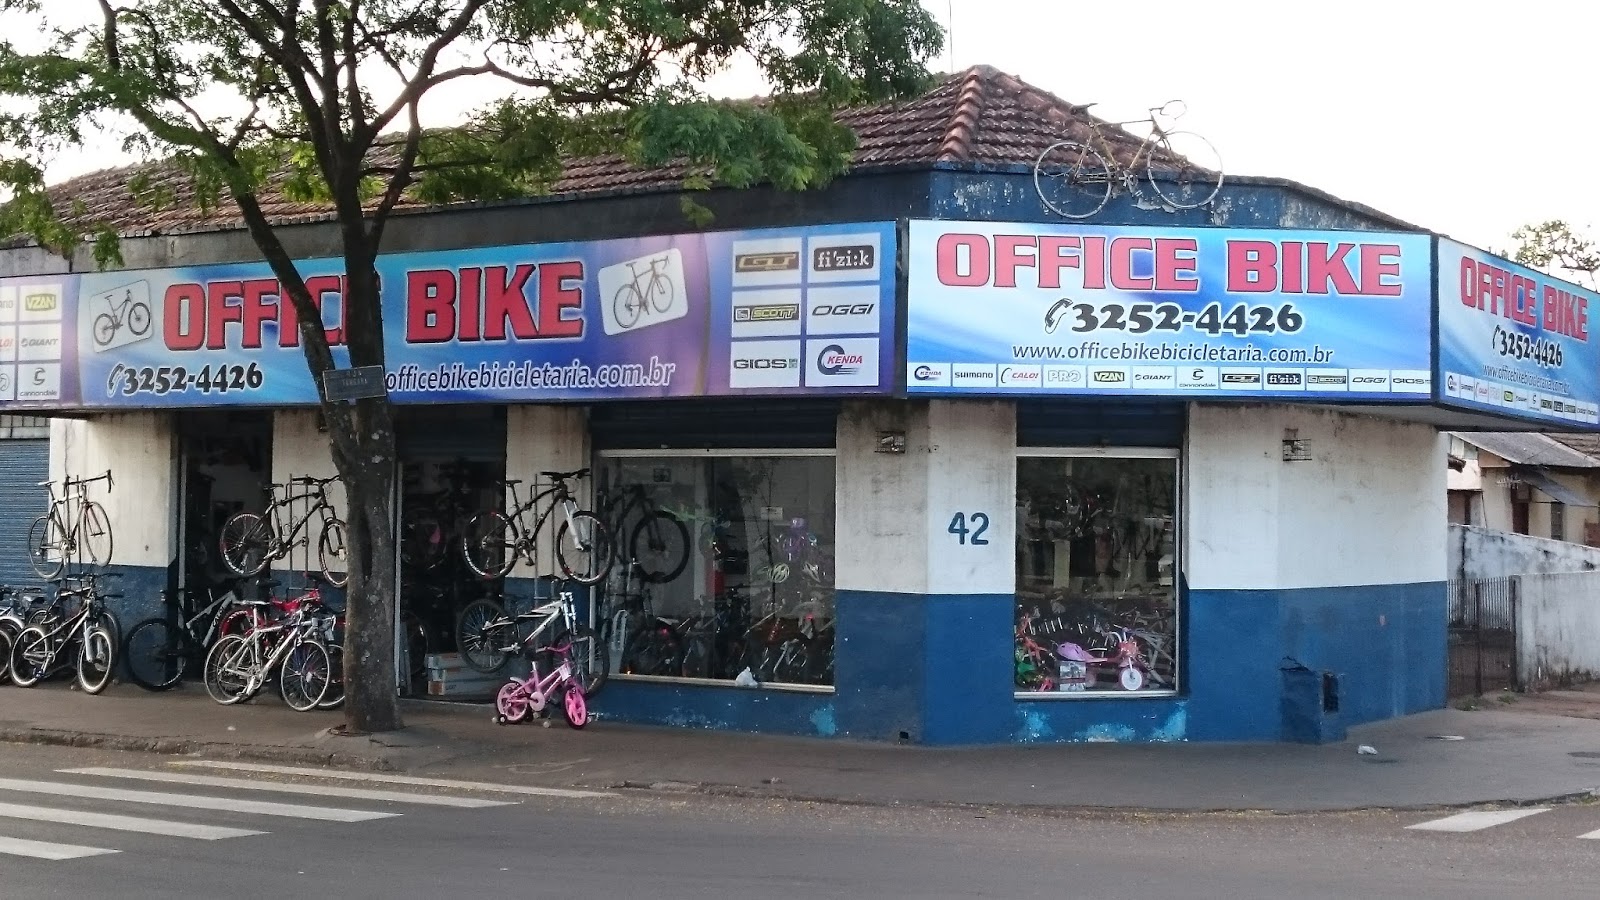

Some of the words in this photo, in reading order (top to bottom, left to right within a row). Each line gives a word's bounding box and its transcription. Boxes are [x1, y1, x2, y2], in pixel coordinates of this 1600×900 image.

[937, 233, 1199, 292] OFFICE
[1227, 240, 1403, 296] BIKE
[26, 296, 56, 310] VZAN
[163, 275, 381, 351] OFFIC
[406, 261, 587, 344] BIKE
[1460, 256, 1537, 327] OFFICE
[1543, 284, 1589, 342] BIKE
[751, 306, 797, 320] SCOTT
[812, 303, 875, 316] OGGI
[1071, 301, 1304, 334] 3252-4426
[1012, 343, 1334, 364] www.officebikebicicletaria.com.br
[1499, 330, 1563, 367] 3252-4426
[733, 358, 788, 370] GIOS
[827, 355, 864, 365] KENDA
[122, 362, 264, 395] 3252-4426
[1094, 371, 1125, 382] VZAN
[1352, 376, 1387, 384] OGGI
[20, 389, 57, 397] cannondale
[947, 511, 990, 546] 42
